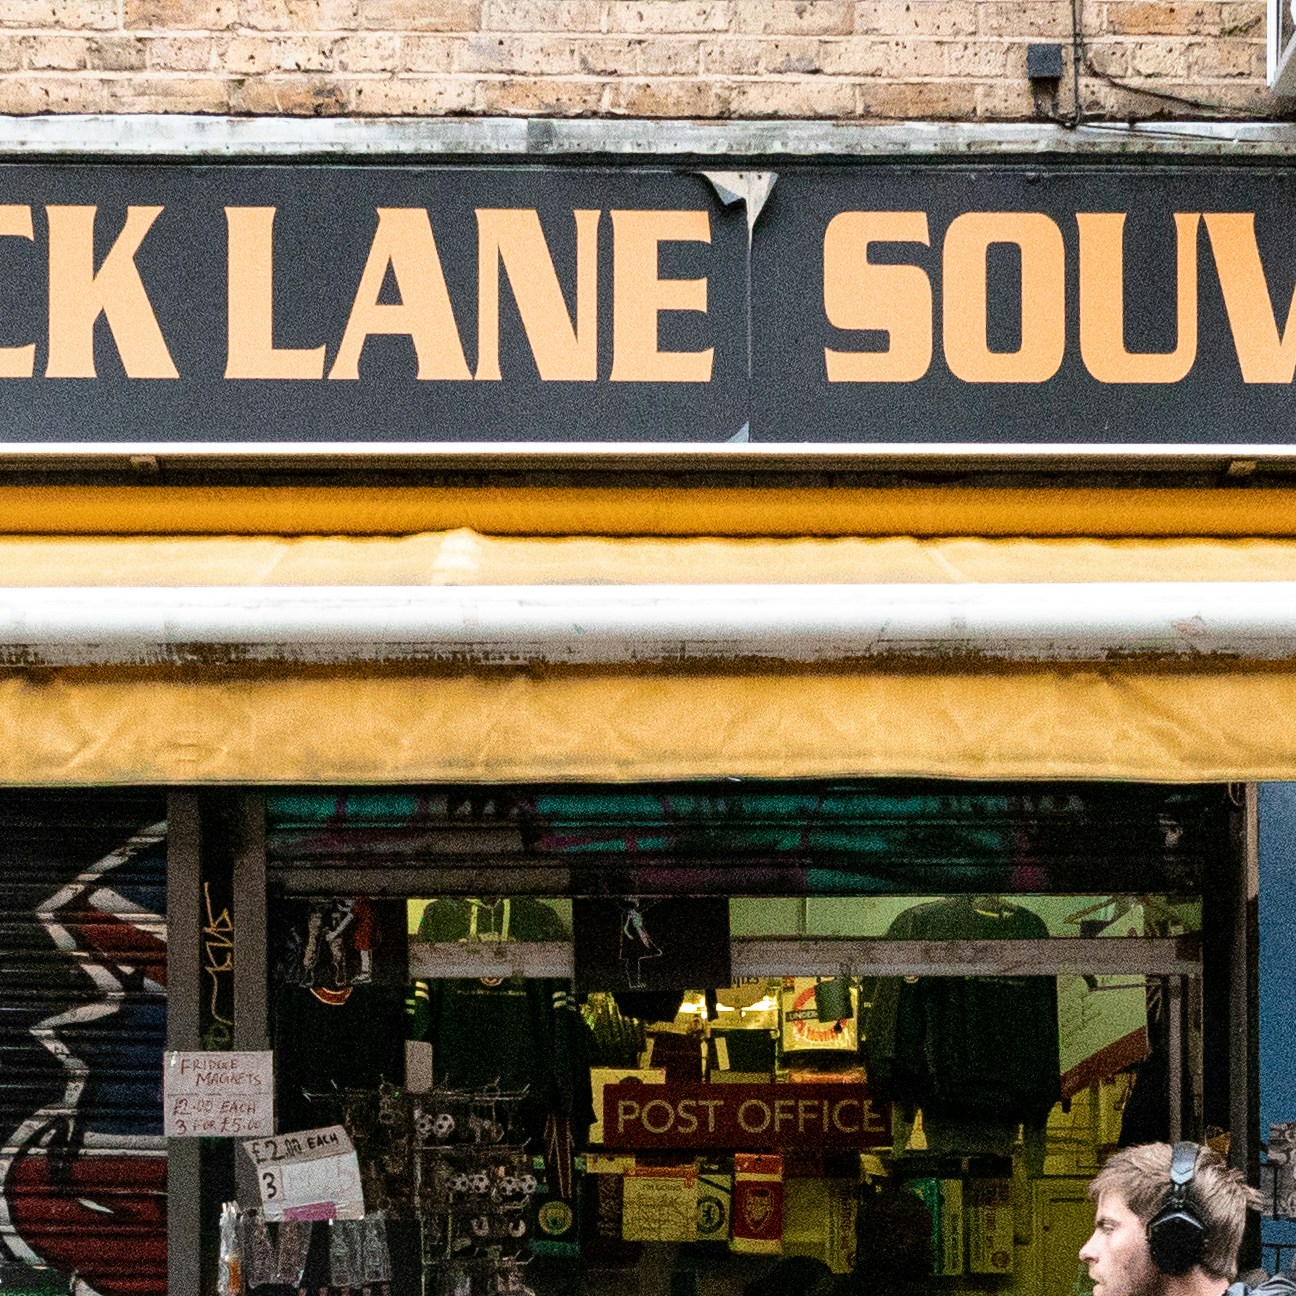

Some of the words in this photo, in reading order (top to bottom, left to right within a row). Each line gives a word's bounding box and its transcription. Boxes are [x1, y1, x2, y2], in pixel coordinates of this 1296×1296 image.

[224, 206, 715, 382] LANE
[219, 1101, 256, 1115] EACH
[617, 1099, 724, 1134] POST
[737, 1099, 886, 1134] OFFICE
[175, 1119, 188, 1136] 3
[307, 1132, 340, 1150] EACH
[262, 1171, 278, 1200] 3
